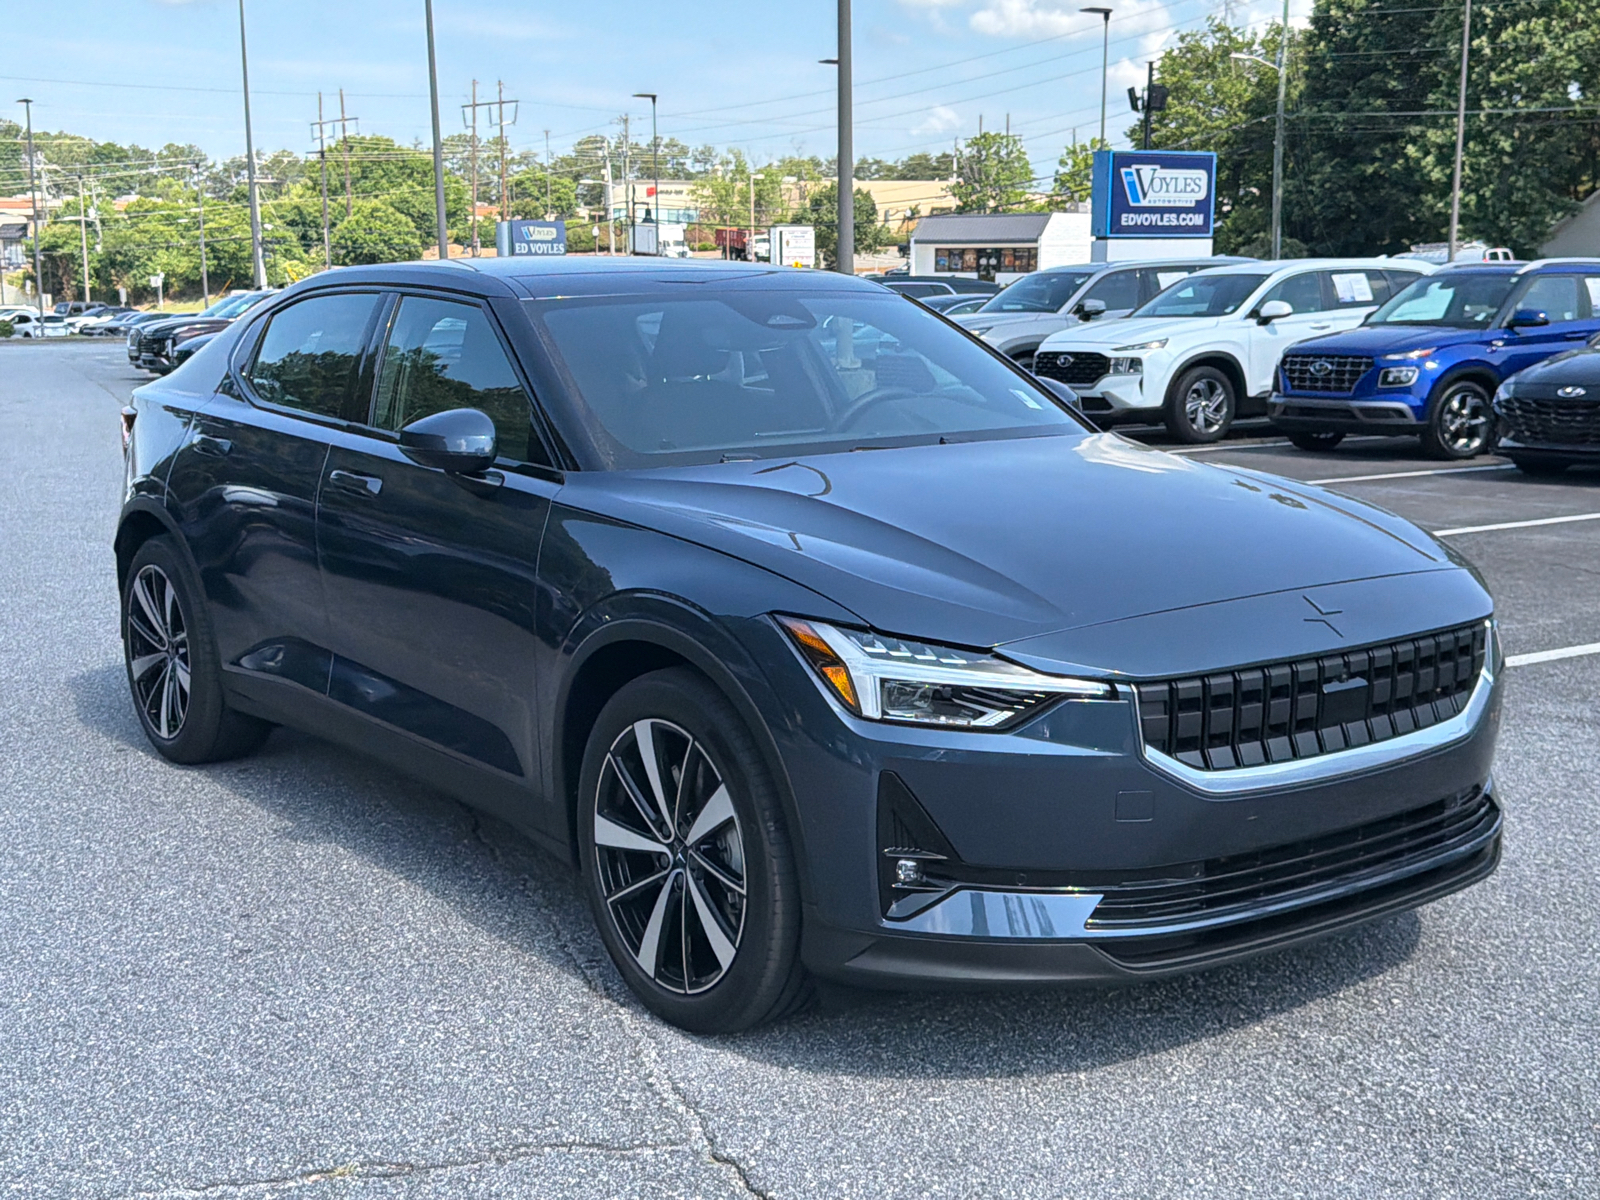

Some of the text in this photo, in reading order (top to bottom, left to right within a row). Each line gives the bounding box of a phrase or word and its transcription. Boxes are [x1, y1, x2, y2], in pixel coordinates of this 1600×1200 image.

[1134, 168, 1202, 200] VOYLES
[1121, 213, 1204, 226] EDVOYLES.COM
[515, 243, 565, 254] ED VOYLES
